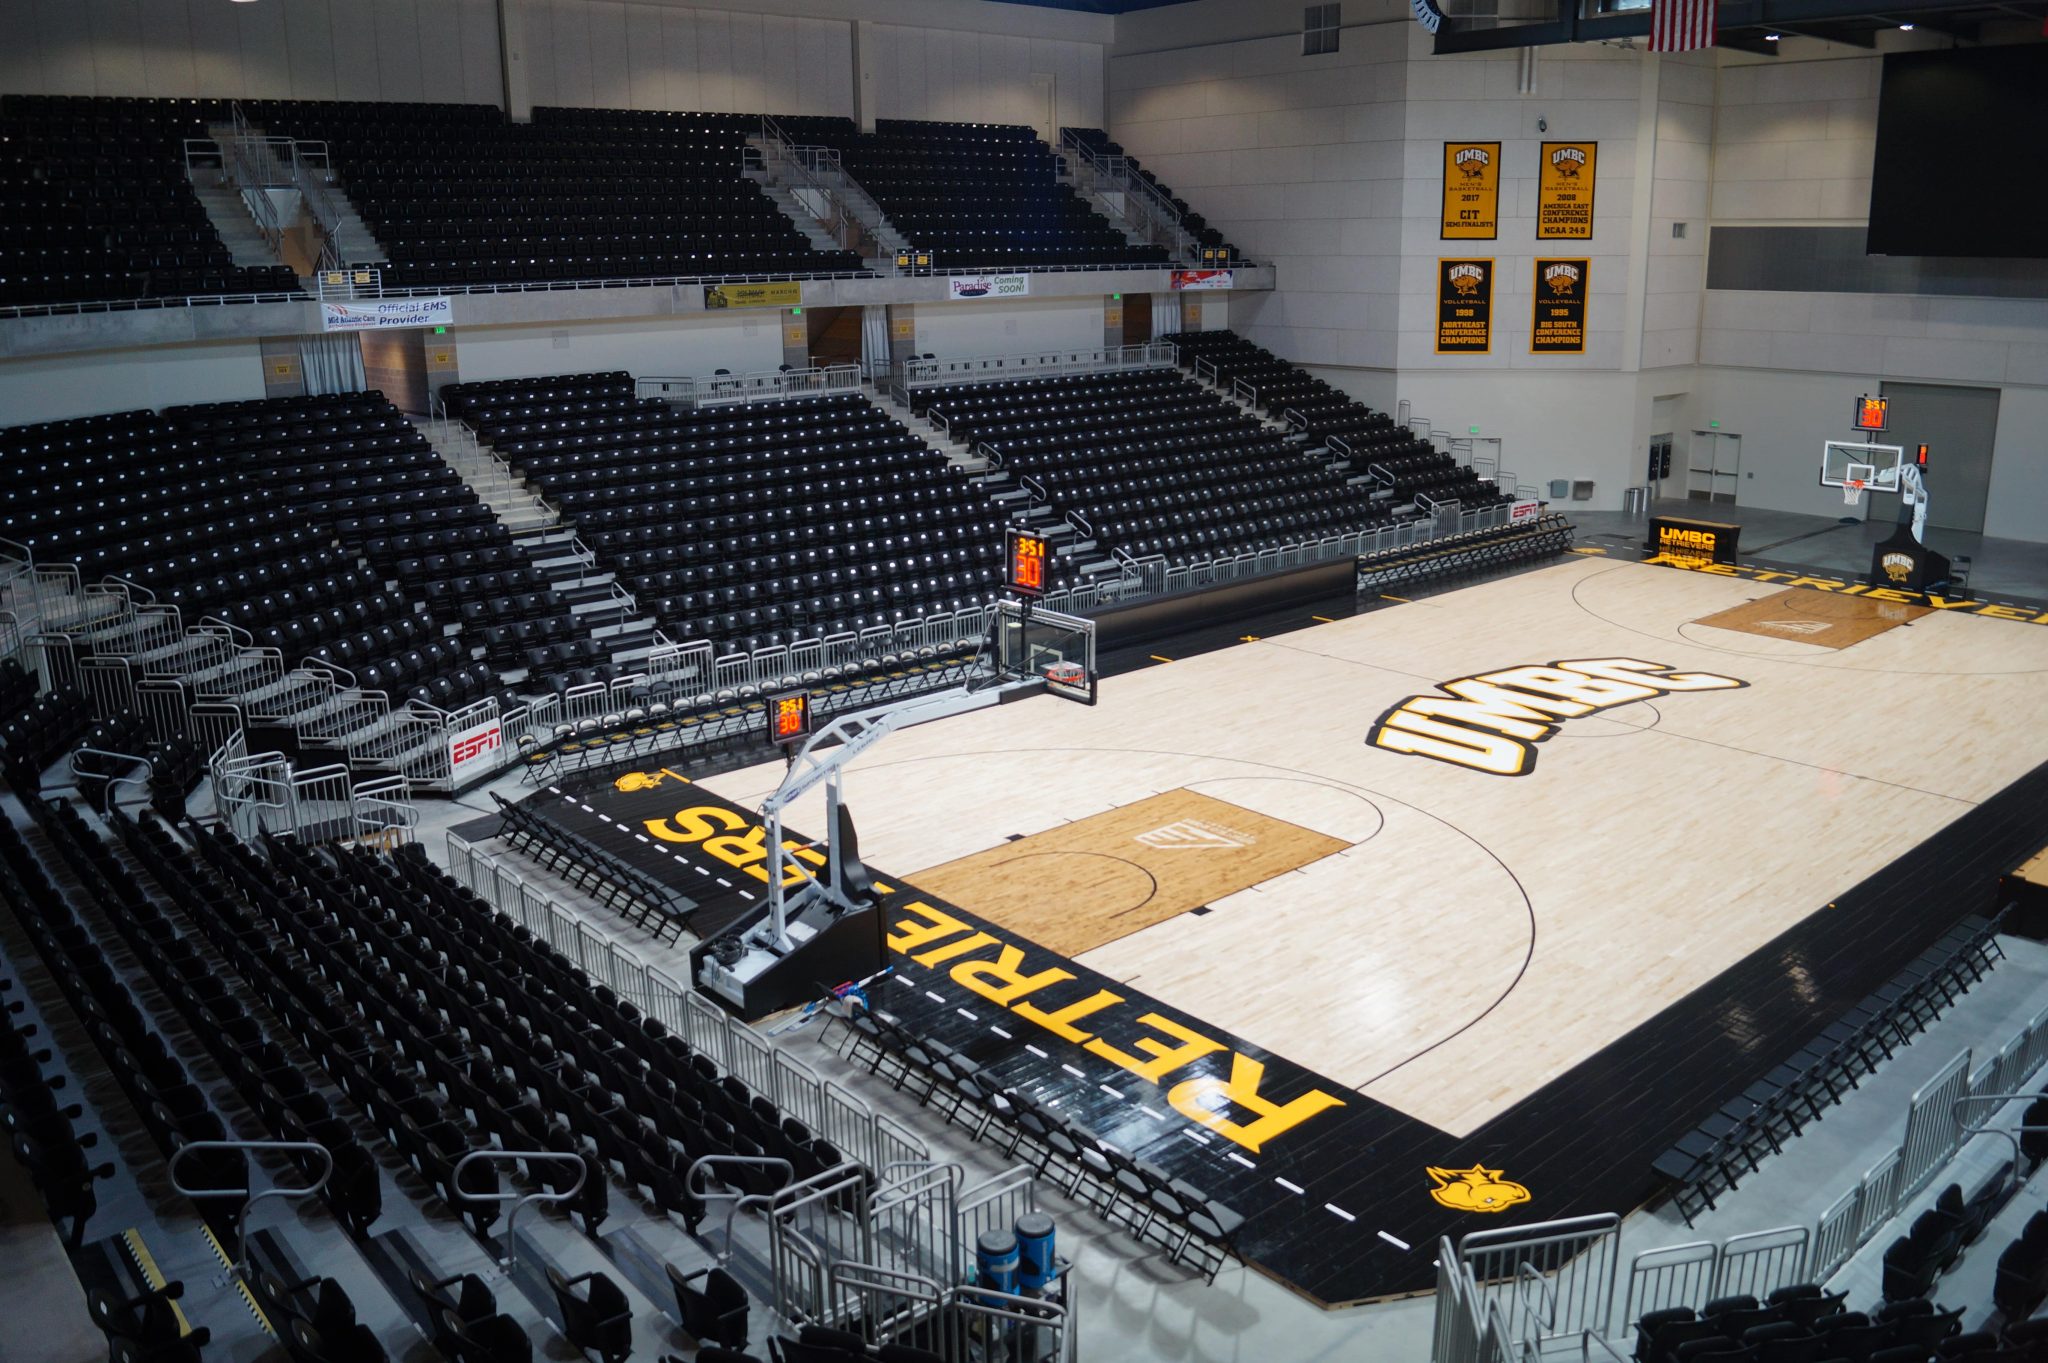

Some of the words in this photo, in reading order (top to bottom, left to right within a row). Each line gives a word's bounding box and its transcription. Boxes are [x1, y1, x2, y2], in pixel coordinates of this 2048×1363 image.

[1456, 149, 1489, 165] UMBC
[1552, 148, 1585, 164] UMBC
[1556, 193, 1576, 201] 2008
[1459, 210, 1480, 220] CIT
[1450, 264, 1484, 280] UMBC
[1546, 264, 1579, 280] UMBC
[953, 279, 993, 292] Paradise
[994, 276, 1025, 285] Coming
[998, 284, 1025, 294] SOON!
[378, 302, 420, 314] Official
[423, 301, 447, 311] EMS
[1455, 308, 1474, 316] 1998
[1550, 308, 1569, 316] 1995
[379, 315, 430, 325] Provider
[1440, 336, 1486, 344] CHAMPIONS
[1535, 336, 1581, 344] CHAMPIONS
[1865, 399, 1886, 410] 3:51
[1862, 408, 1883, 428] 30
[1513, 503, 1537, 518] ESPN
[1660, 526, 1716, 545] UMBC
[1018, 537, 1044, 557] 3:51
[1659, 537, 1715, 551] RETRIEVERS
[1882, 553, 1914, 571] UMBC
[1016, 555, 1040, 587] 30
[780, 697, 804, 714] 3:51
[779, 713, 801, 735] 30
[1366, 657, 1751, 776] UMBC
[453, 727, 501, 765] ESPN
